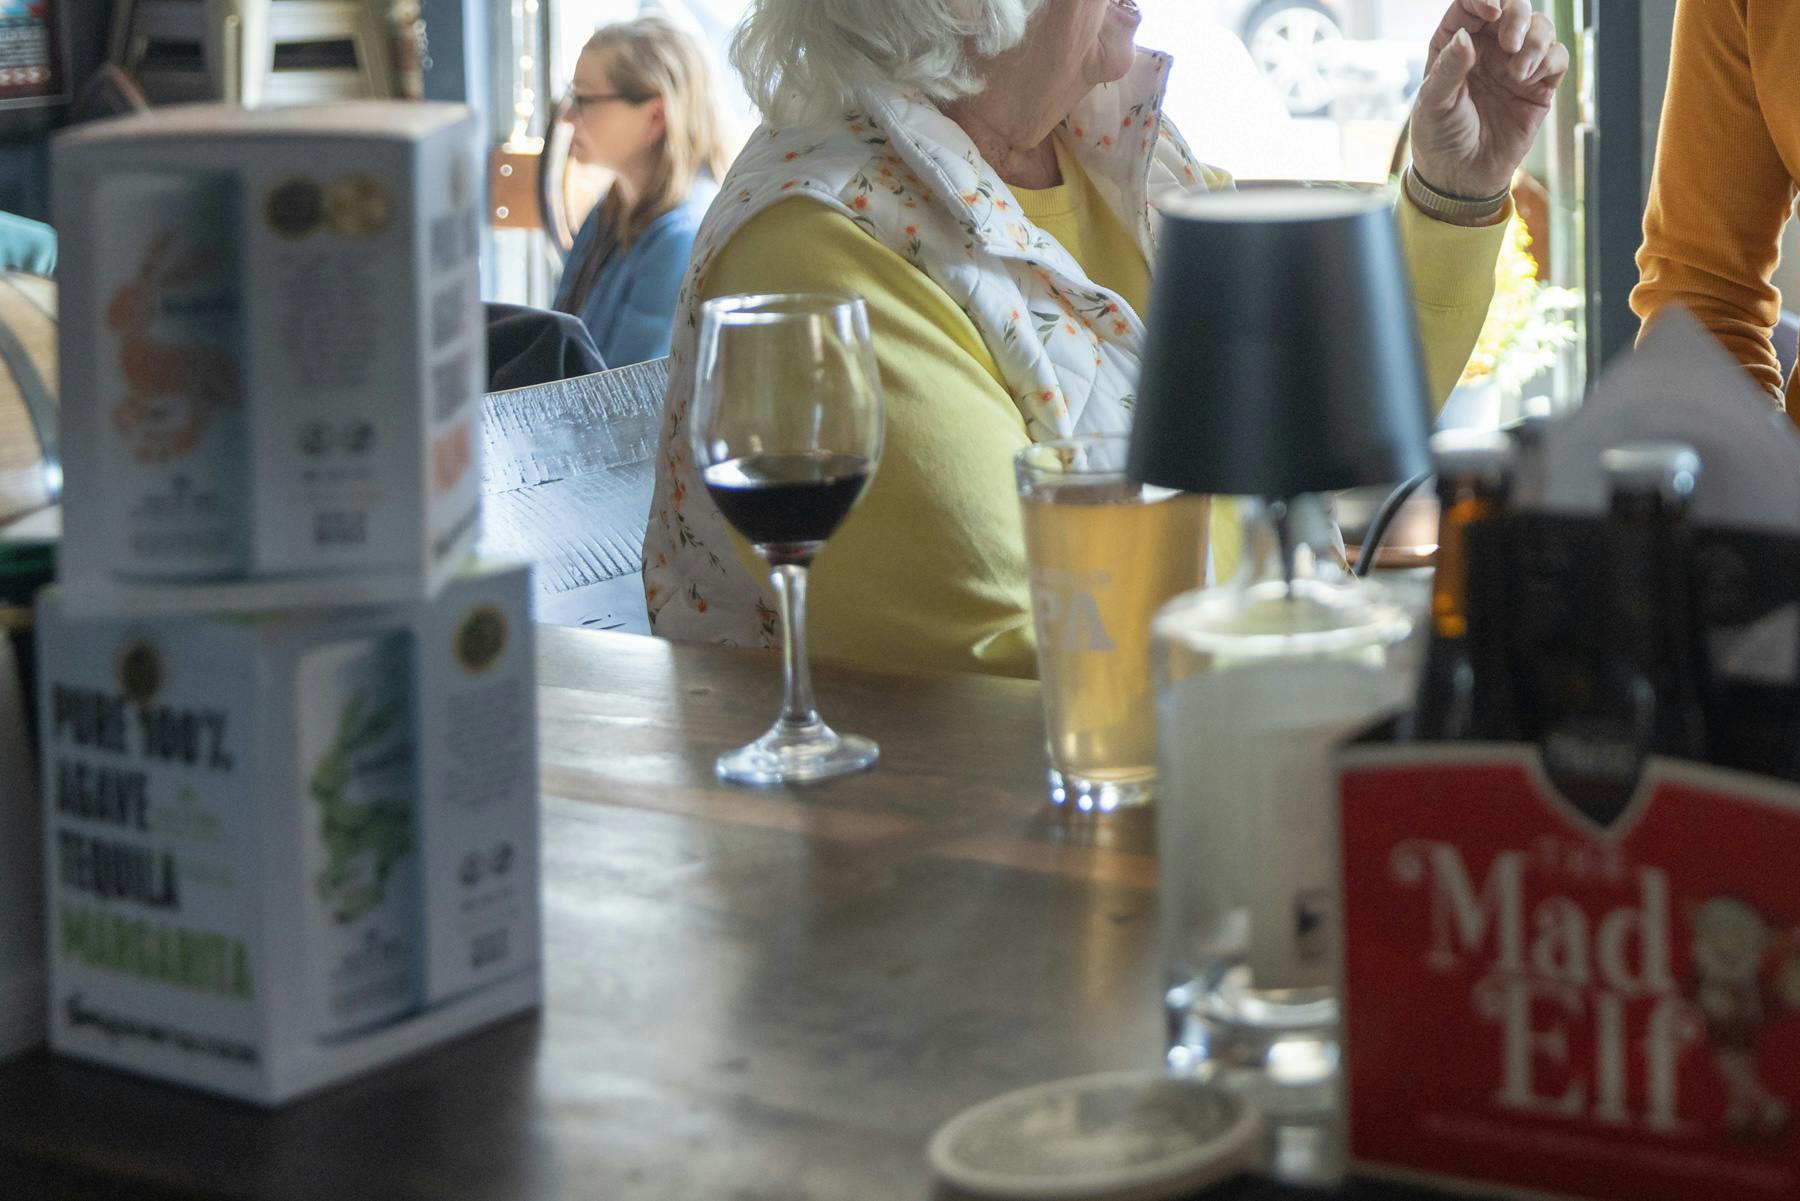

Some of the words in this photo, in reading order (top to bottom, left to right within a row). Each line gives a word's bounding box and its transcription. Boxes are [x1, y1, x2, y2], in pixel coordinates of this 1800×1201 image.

[56, 757, 149, 834] AGAVE
[58, 828, 179, 913] TEQUILA
[1386, 836, 1678, 998] Mad
[1471, 968, 1708, 1137] Elf
